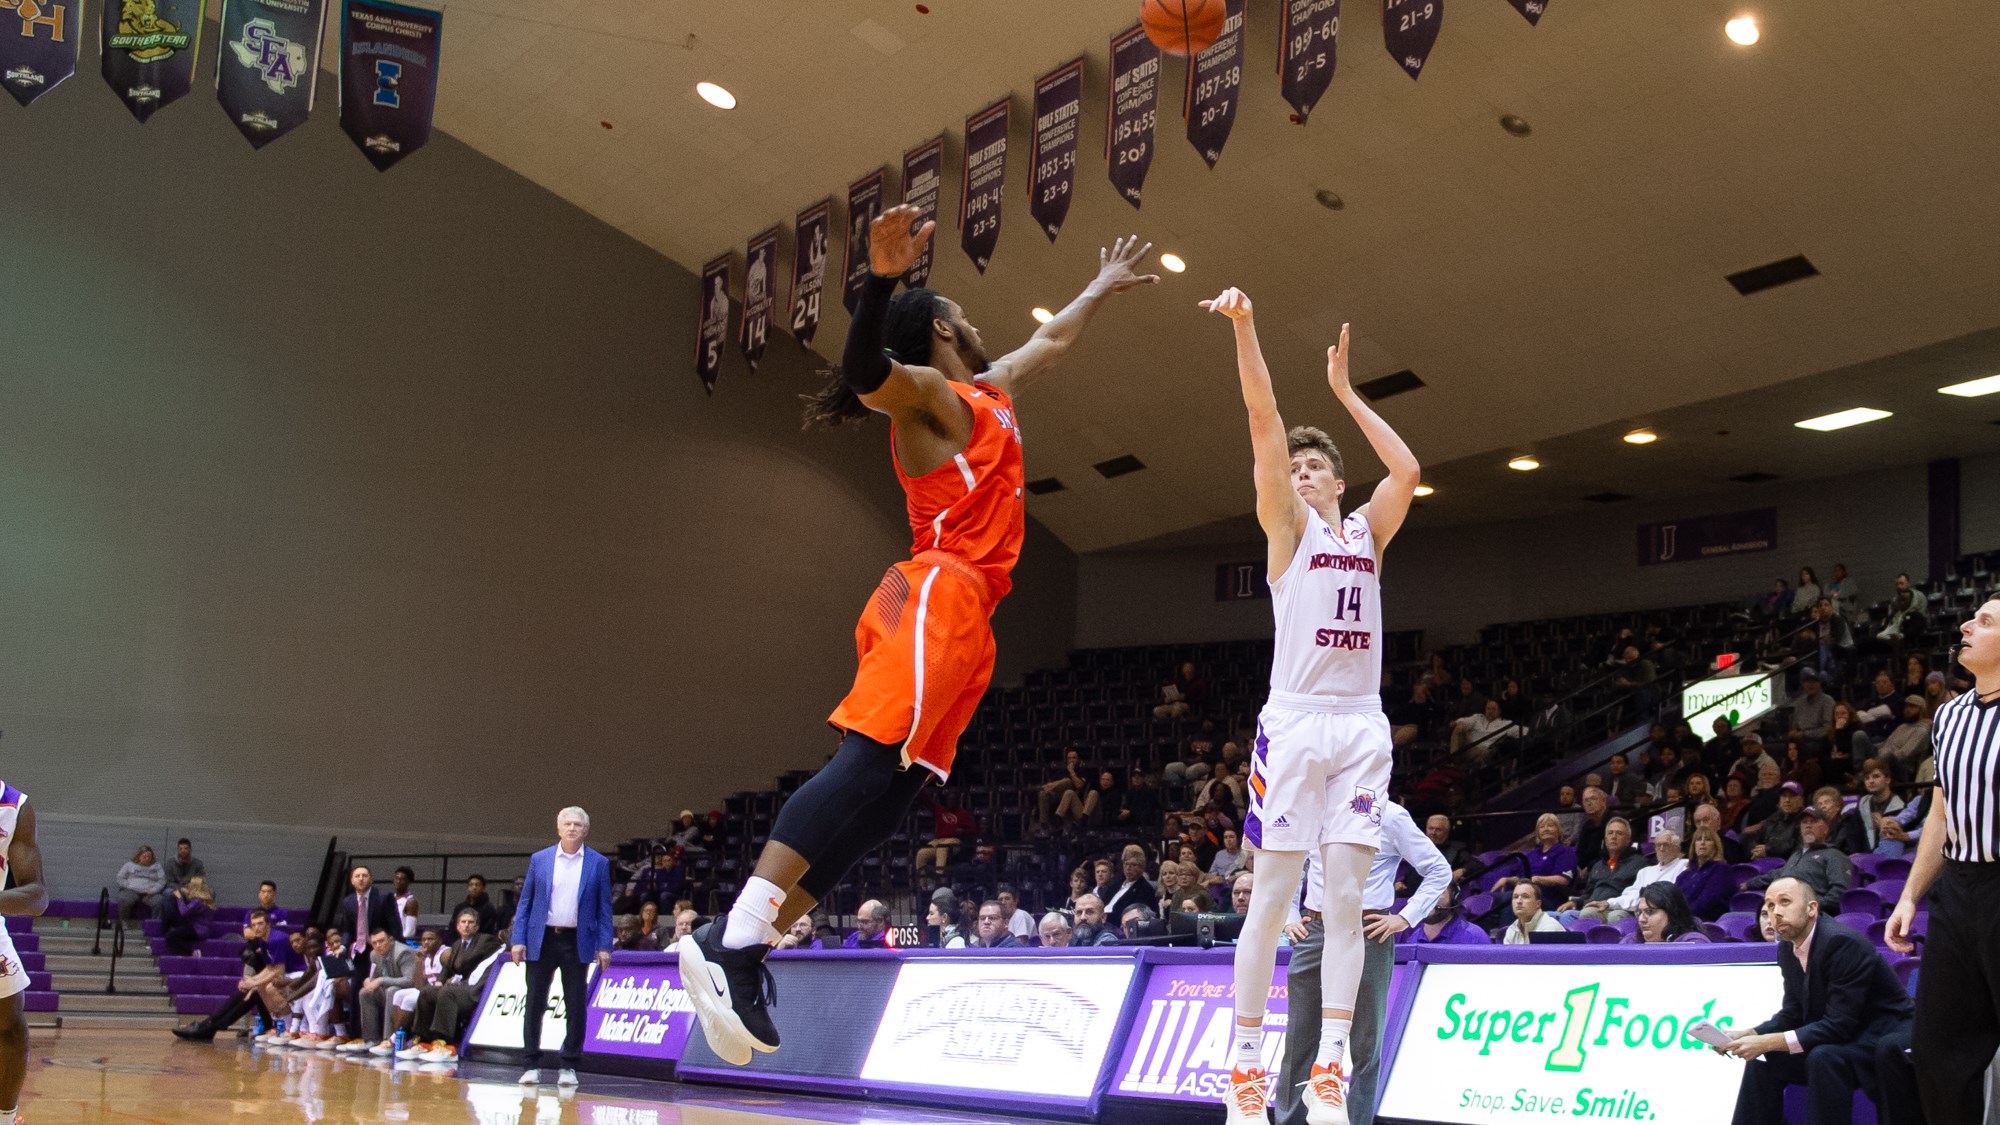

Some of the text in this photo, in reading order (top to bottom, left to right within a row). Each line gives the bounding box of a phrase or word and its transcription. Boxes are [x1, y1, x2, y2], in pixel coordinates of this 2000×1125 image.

[351, 11, 433, 33] TEXAS A&M UNIVERSITY
[366, 21, 422, 39] CORPUS CHRISTI
[1400, 3, 1433, 32] 21-9
[112, 34, 187, 47] SOUTHEASTERN
[245, 22, 296, 84] SFA
[1198, 45, 1237, 73] CHAMPIONS
[7, 70, 45, 84] SOUTHLAND
[1195, 66, 1240, 105] 1957-58
[1038, 99, 1079, 133] GULF STATES
[1201, 100, 1229, 127] 20-7
[1039, 118, 1076, 144] CONFERENCE
[1040, 130, 1074, 155] CHAMPIONS
[984, 138, 1007, 161] STATES
[970, 155, 1003, 180] CONFERENCE
[971, 167, 1002, 190] CHAMPIONS
[1037, 149, 1076, 184] 1953-54
[1043, 180, 1069, 204] 23-9
[1127, 187, 1140, 199] NS
[973, 214, 997, 237] 23-5
[793, 292, 820, 329] 24
[748, 314, 766, 351] 14
[707, 340, 718, 369] 5
[1660, 525, 1677, 560] J
[1333, 586, 1362, 622] 14
[1316, 628, 1371, 650] STATE
[893, 927, 920, 946] POSS.
[596, 1013, 670, 1044] Medical Center
[1437, 993, 1557, 1056] Super
[1544, 981, 1600, 1072] 1
[1459, 1087, 1656, 1121] Shop. Save. Smile.
